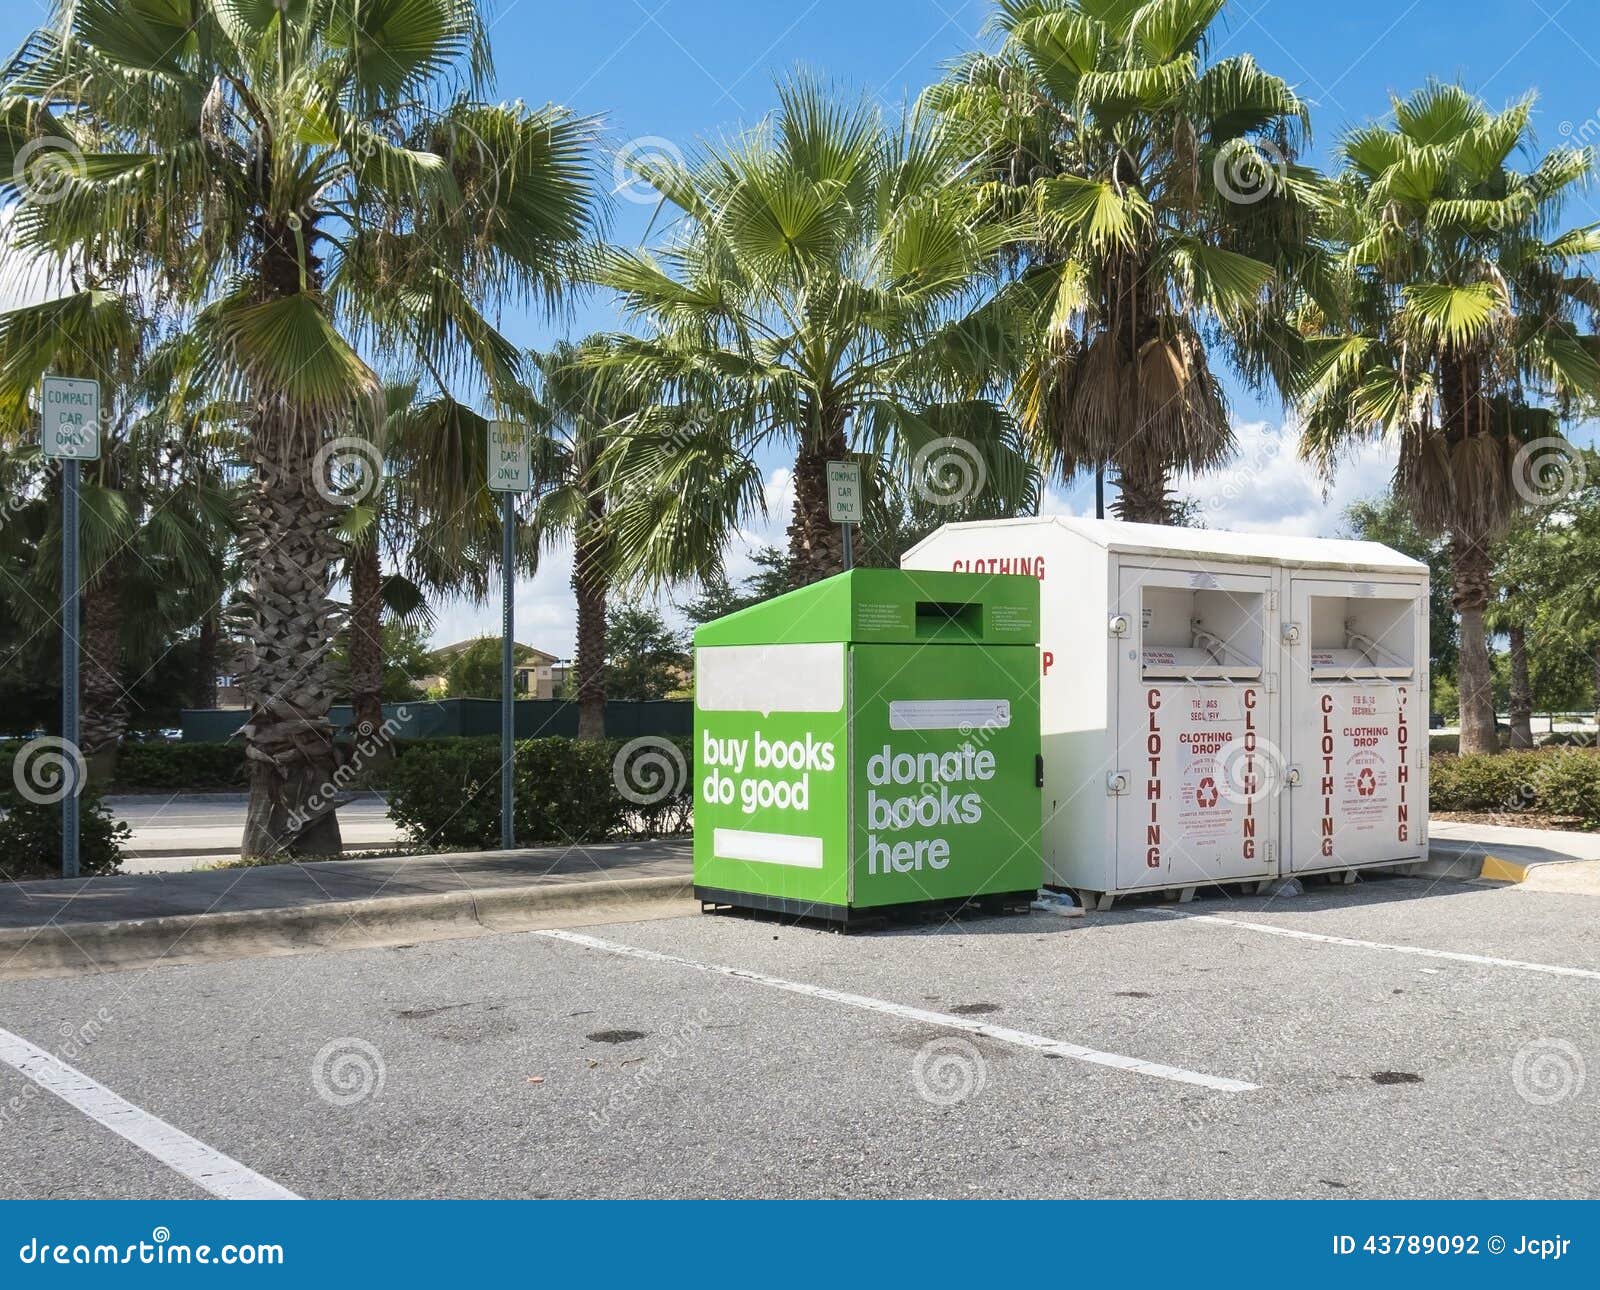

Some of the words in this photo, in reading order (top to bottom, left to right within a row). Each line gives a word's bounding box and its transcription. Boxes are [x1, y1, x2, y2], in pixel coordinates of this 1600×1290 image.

[48, 390, 94, 406] COMPACT
[59, 411, 83, 425] CAR
[55, 431, 85, 446] ONLY
[500, 450, 518, 462] CAR
[497, 467, 520, 480] ONLY
[831, 471, 857, 482] COMPACT
[837, 487, 852, 497] CAR
[836, 502, 854, 513] ONLY
[1179, 732, 1233, 743] CLOTHING
[1343, 727, 1389, 737] CLOTHING
[1191, 743, 1221, 754] DROP
[1353, 737, 1379, 747] DROP
[703, 729, 749, 774] buy
[754, 730, 836, 772] books
[866, 744, 996, 787] donate
[1146, 688, 1161, 868] CLOTHING
[1243, 689, 1257, 859] CLOTHING
[1321, 694, 1334, 857] CLOTHING
[703, 767, 736, 806] do
[740, 772, 809, 814] good
[867, 785, 982, 831] books
[868, 834, 950, 875] here
